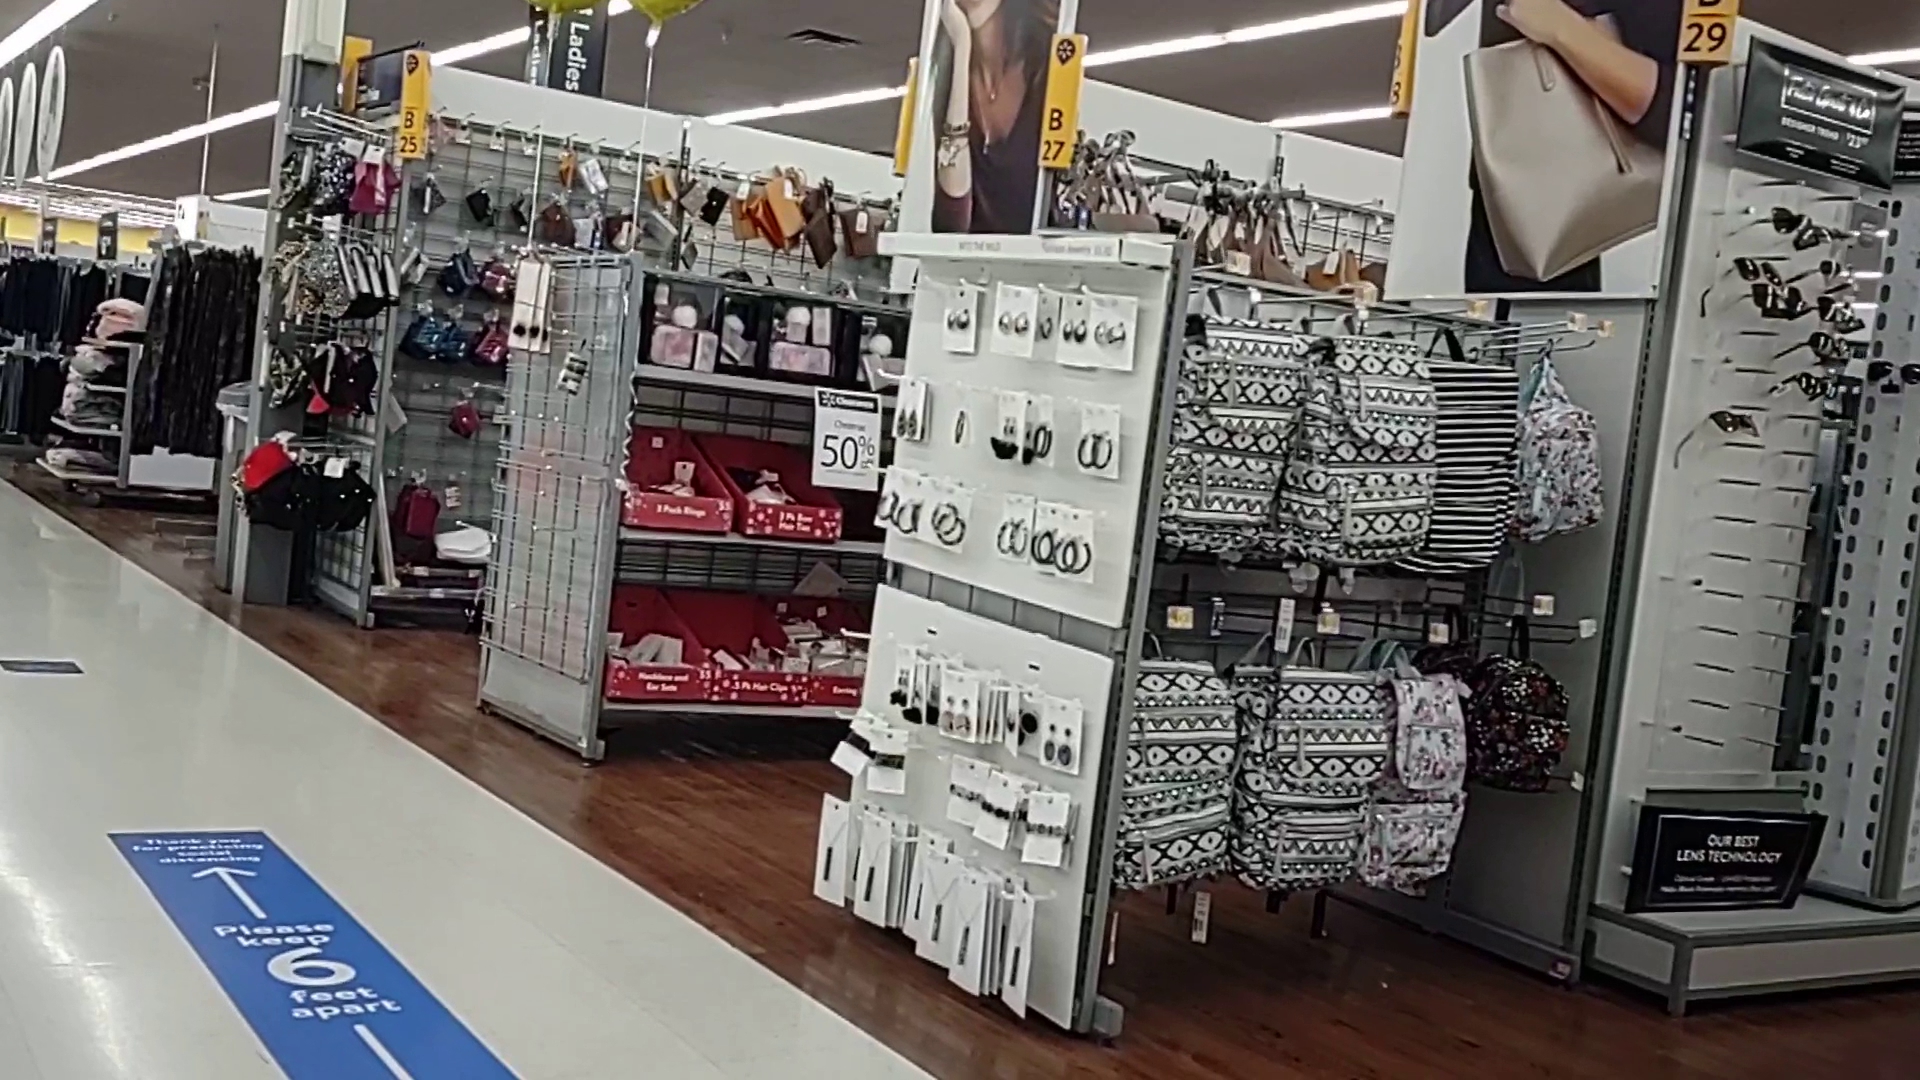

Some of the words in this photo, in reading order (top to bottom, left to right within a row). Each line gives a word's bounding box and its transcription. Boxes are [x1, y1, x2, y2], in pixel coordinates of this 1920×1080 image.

[1682, 22, 1727, 53] 29
[565, 22, 590, 91] Ladies
[404, 111, 414, 129] B
[1049, 108, 1063, 130] B
[400, 136, 417, 153] 25
[1042, 140, 1065, 161] 27
[820, 434, 876, 469] 50%
[167, 844, 264, 852] practicing
[1707, 834, 1732, 847] OUR
[1734, 835, 1760, 848] BEST
[159, 856, 261, 864] distancing
[1676, 850, 1706, 862] LENS
[1708, 850, 1783, 863] TECHNOLOGY
[213, 924, 335, 937] Please
[236, 934, 331, 947] keep
[267, 946, 357, 987] 6
[289, 987, 378, 1004] feet
[290, 999, 402, 1021] apart
